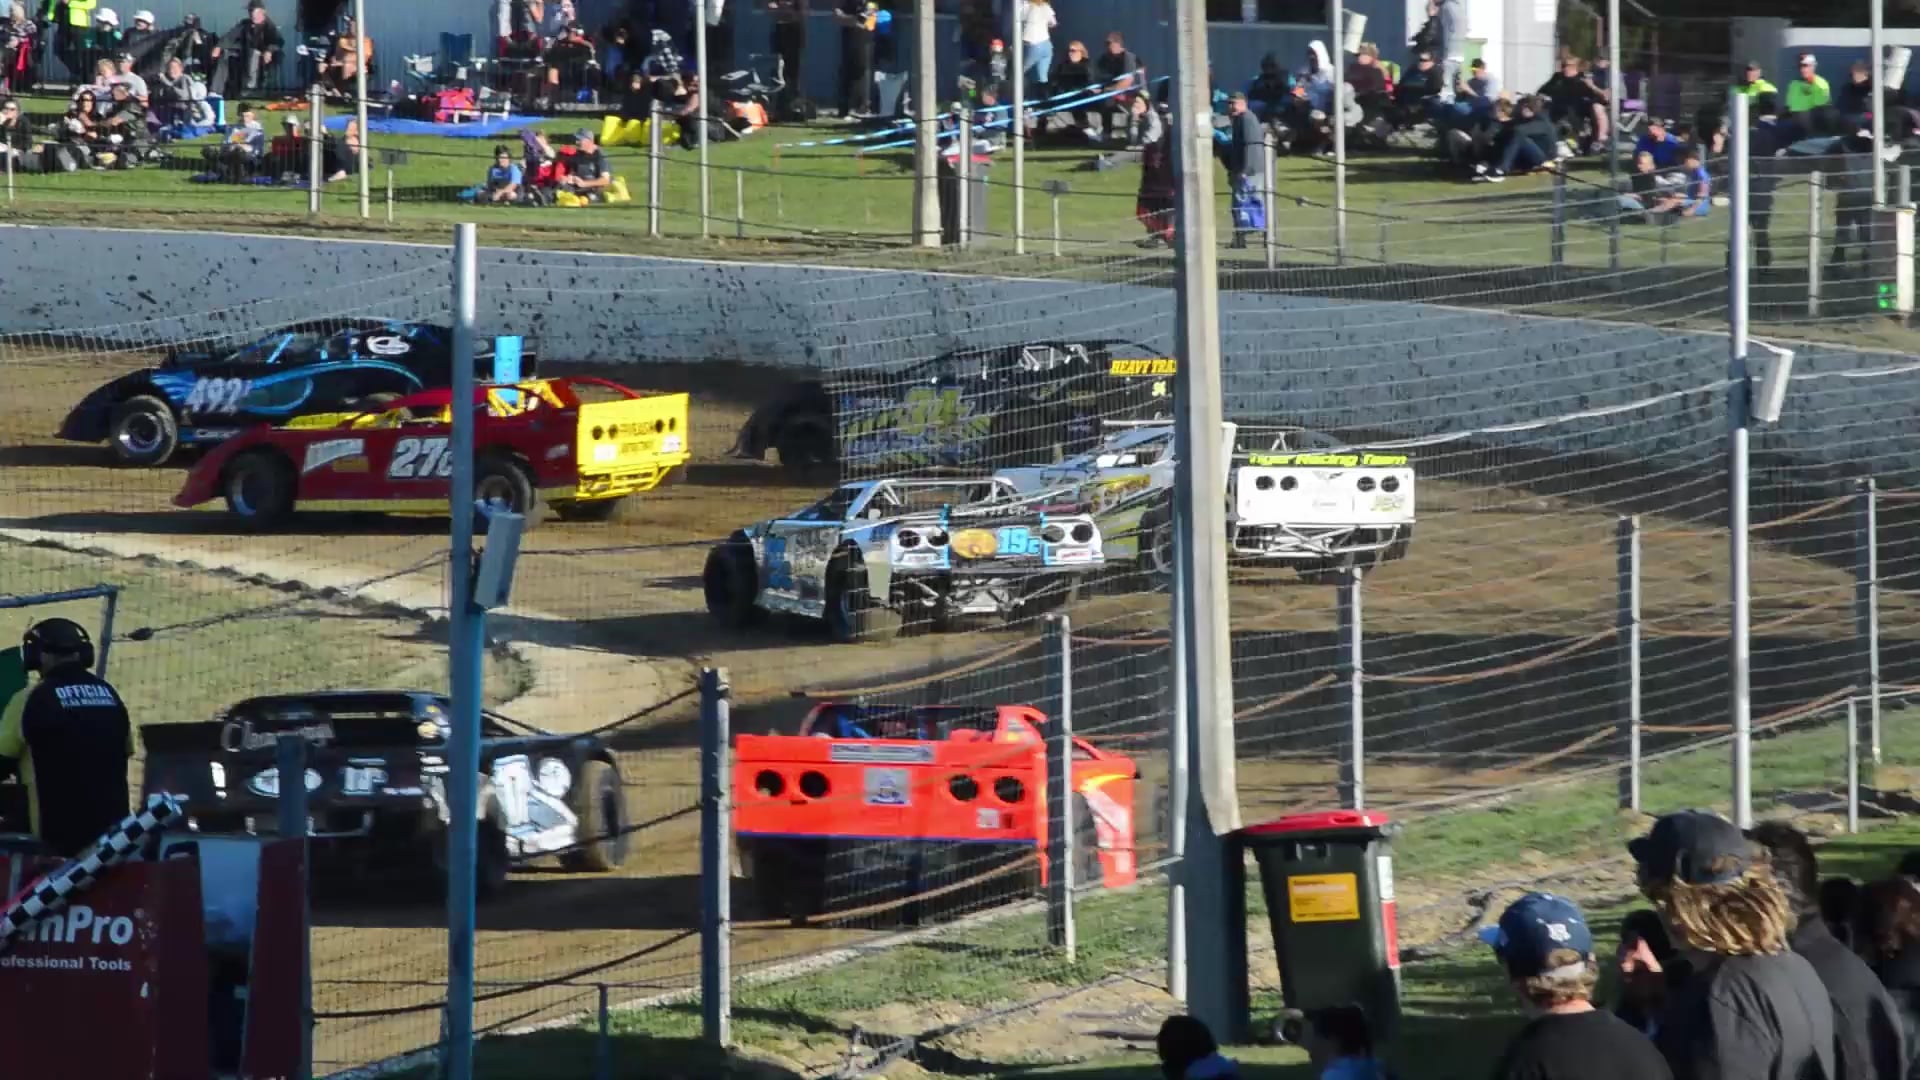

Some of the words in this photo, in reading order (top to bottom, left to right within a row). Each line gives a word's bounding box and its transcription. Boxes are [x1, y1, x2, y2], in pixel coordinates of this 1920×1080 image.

[1110, 360, 1152, 375] HEAVY
[1151, 360, 1177, 374] TRA
[1295, 453, 1360, 467] Racing
[1363, 452, 1409, 466] Team
[55, 684, 113, 699] OFFICIAL
[88, 957, 132, 971] Tools
